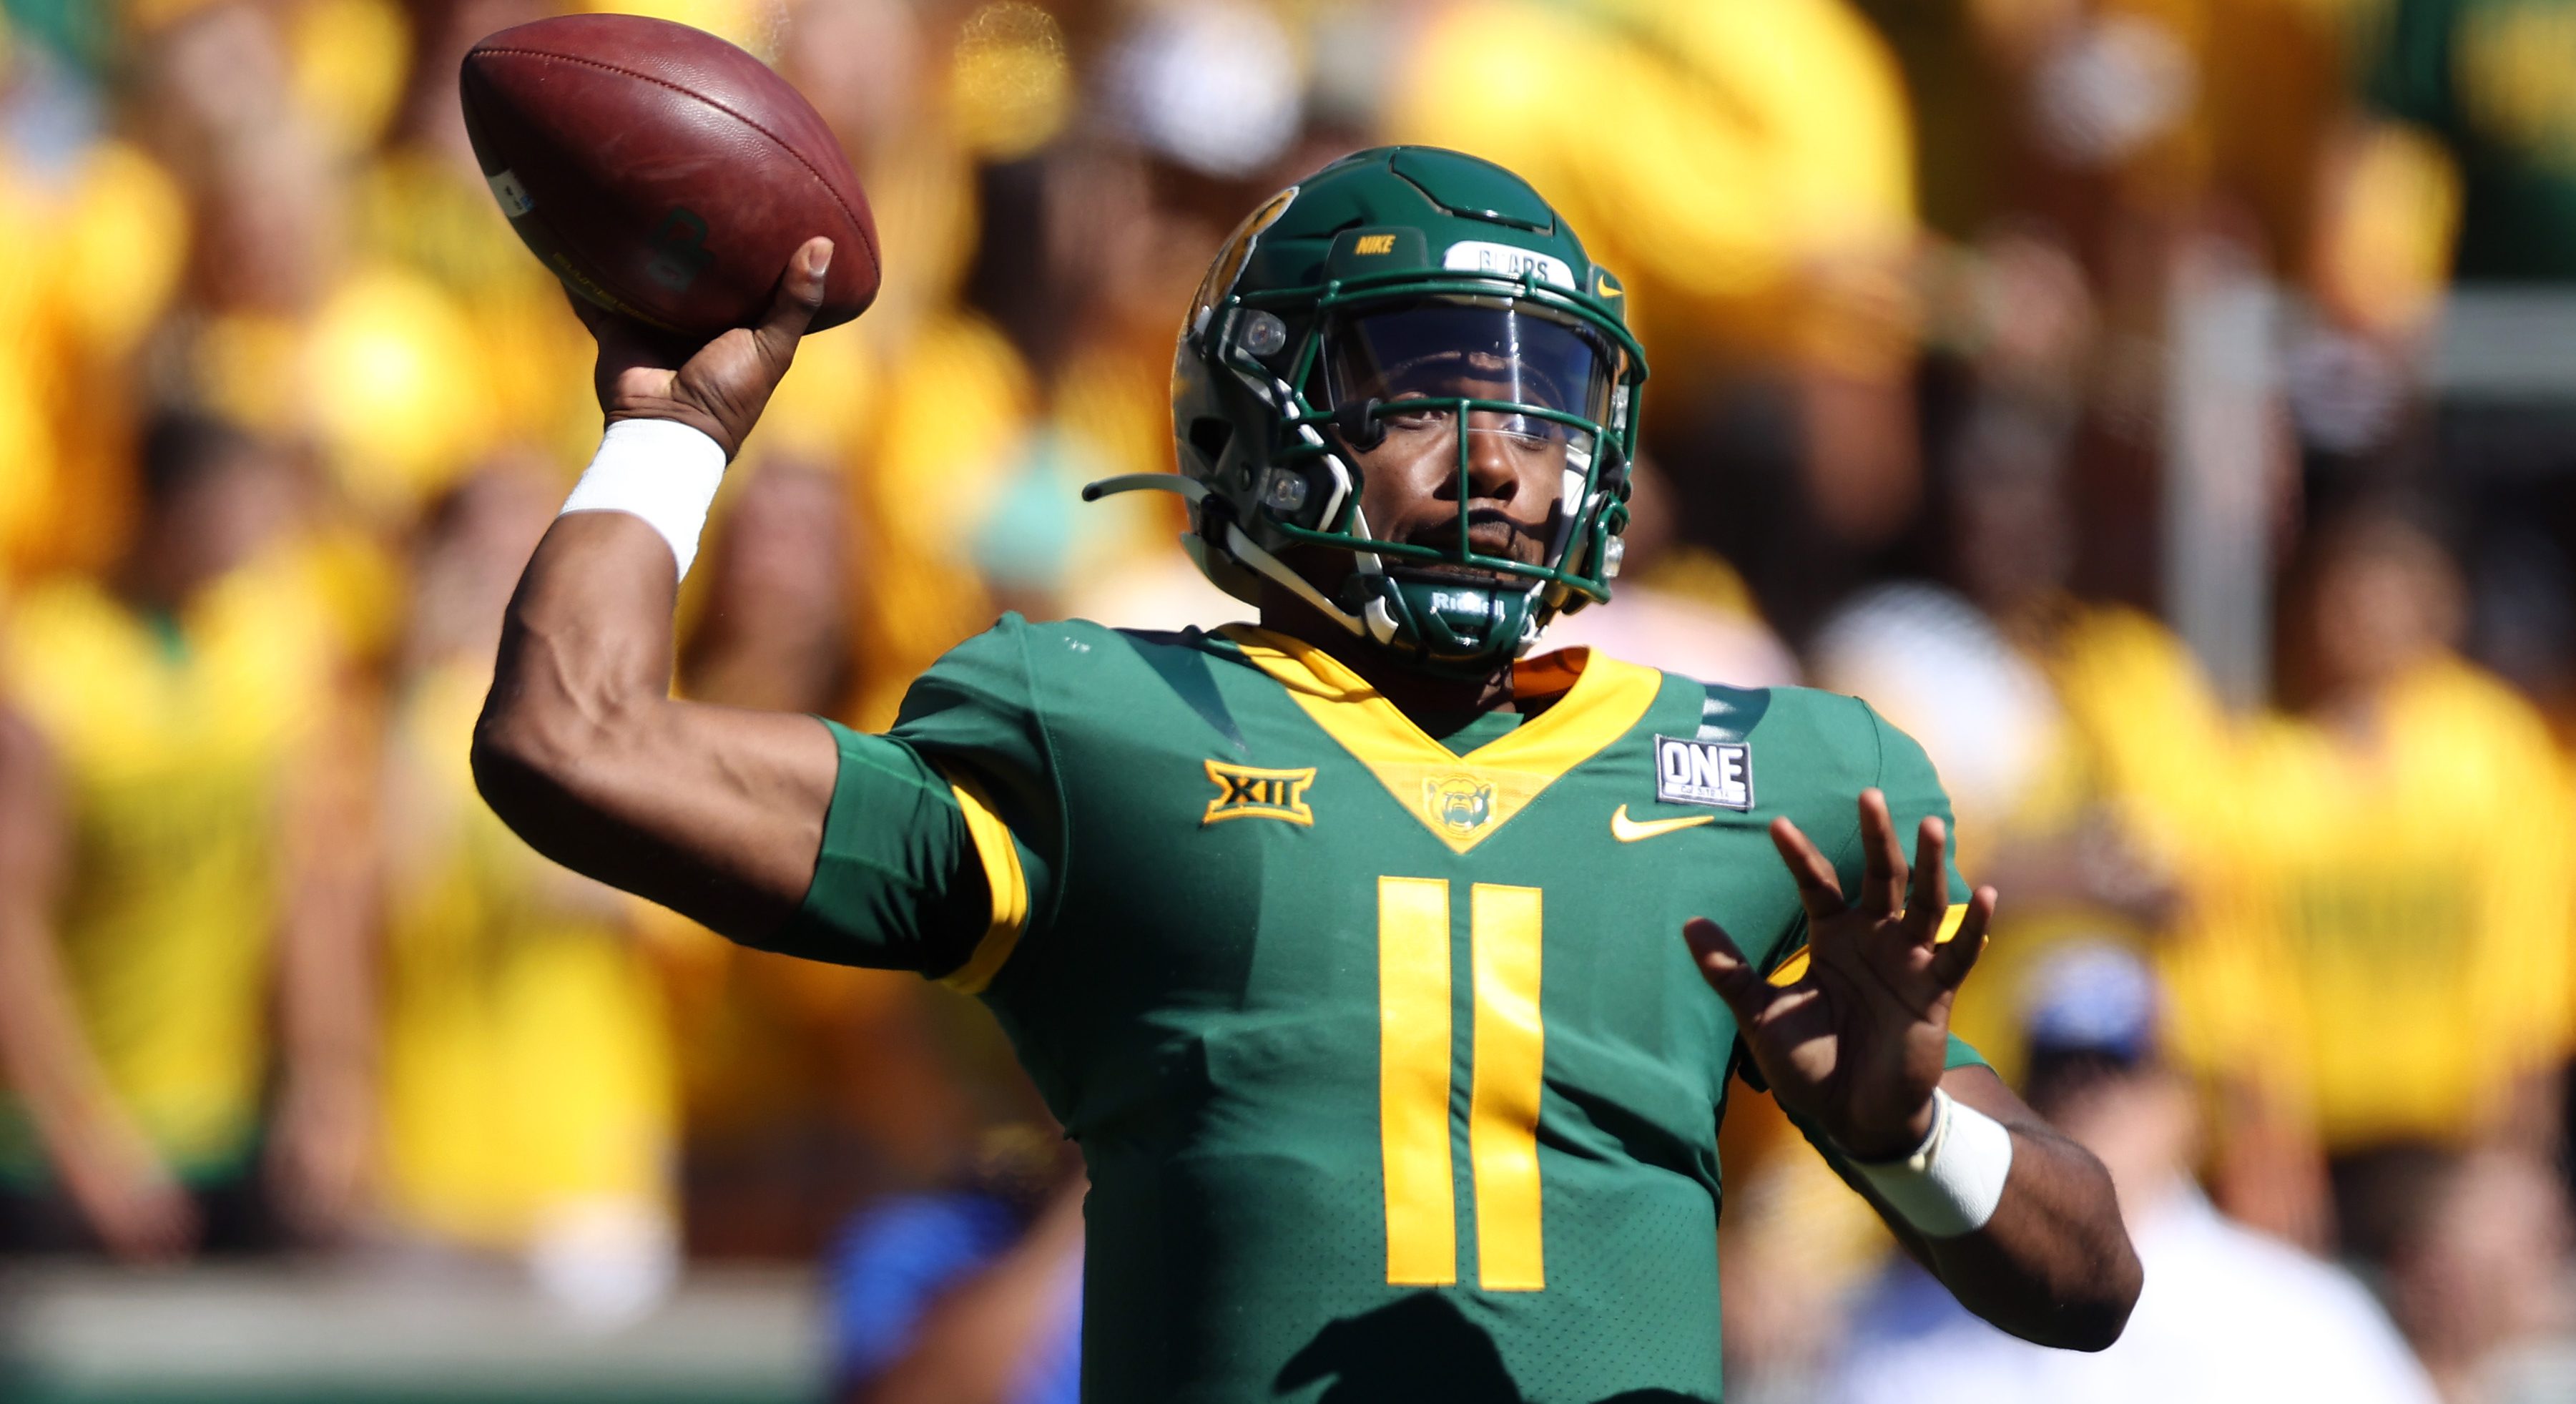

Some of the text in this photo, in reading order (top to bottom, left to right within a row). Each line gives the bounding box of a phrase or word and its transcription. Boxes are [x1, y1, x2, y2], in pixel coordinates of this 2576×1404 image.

[1355, 233, 1396, 255] NIKE
[1479, 250, 1548, 282] BARS
[1661, 741, 1746, 792] ONE
[1378, 875, 1545, 1292] 11
